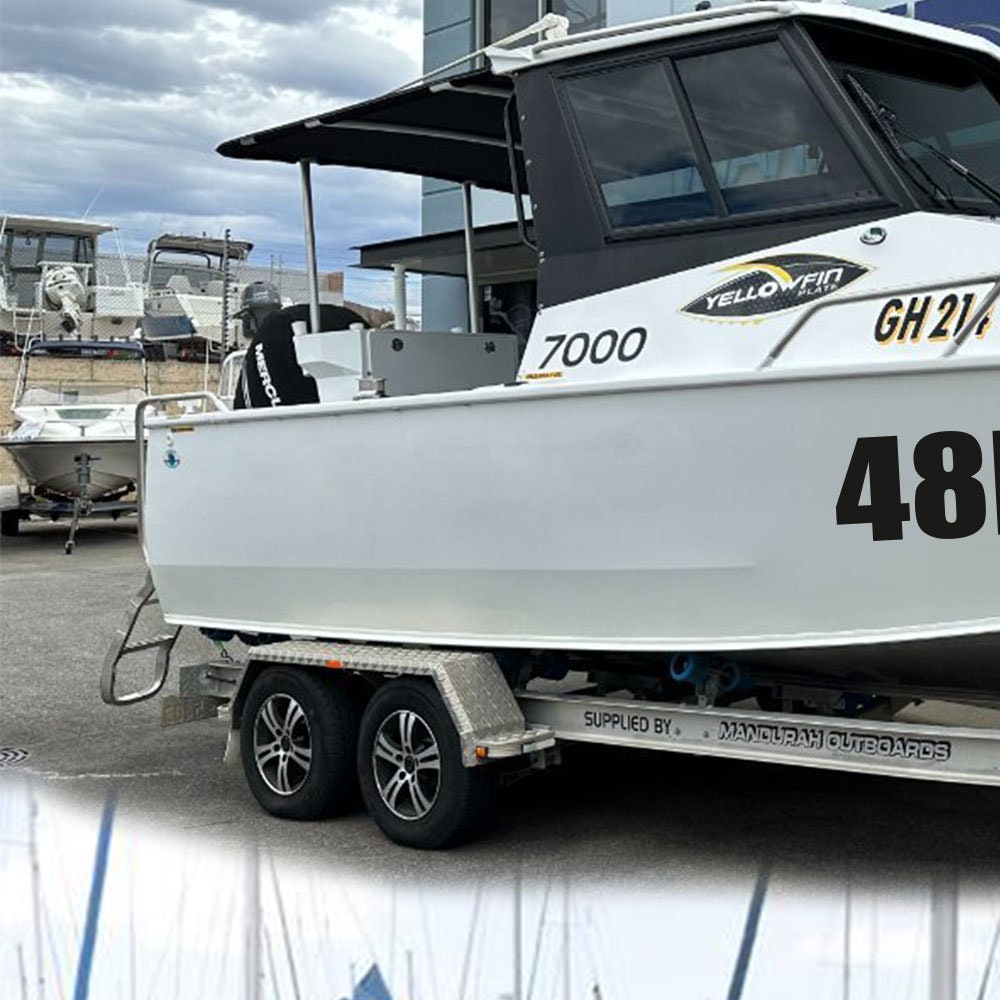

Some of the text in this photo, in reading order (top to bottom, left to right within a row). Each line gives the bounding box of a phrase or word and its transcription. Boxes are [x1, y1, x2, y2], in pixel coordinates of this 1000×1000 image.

[705, 267, 844, 310] YELLOWFIN
[797, 285, 838, 297] PLATE
[874, 293, 993, 344] GH 21
[538, 326, 648, 369] 7000
[584, 710, 673, 735] SUPPLIED BY
[718, 721, 952, 762] MANDURAH OUTBOARDS
